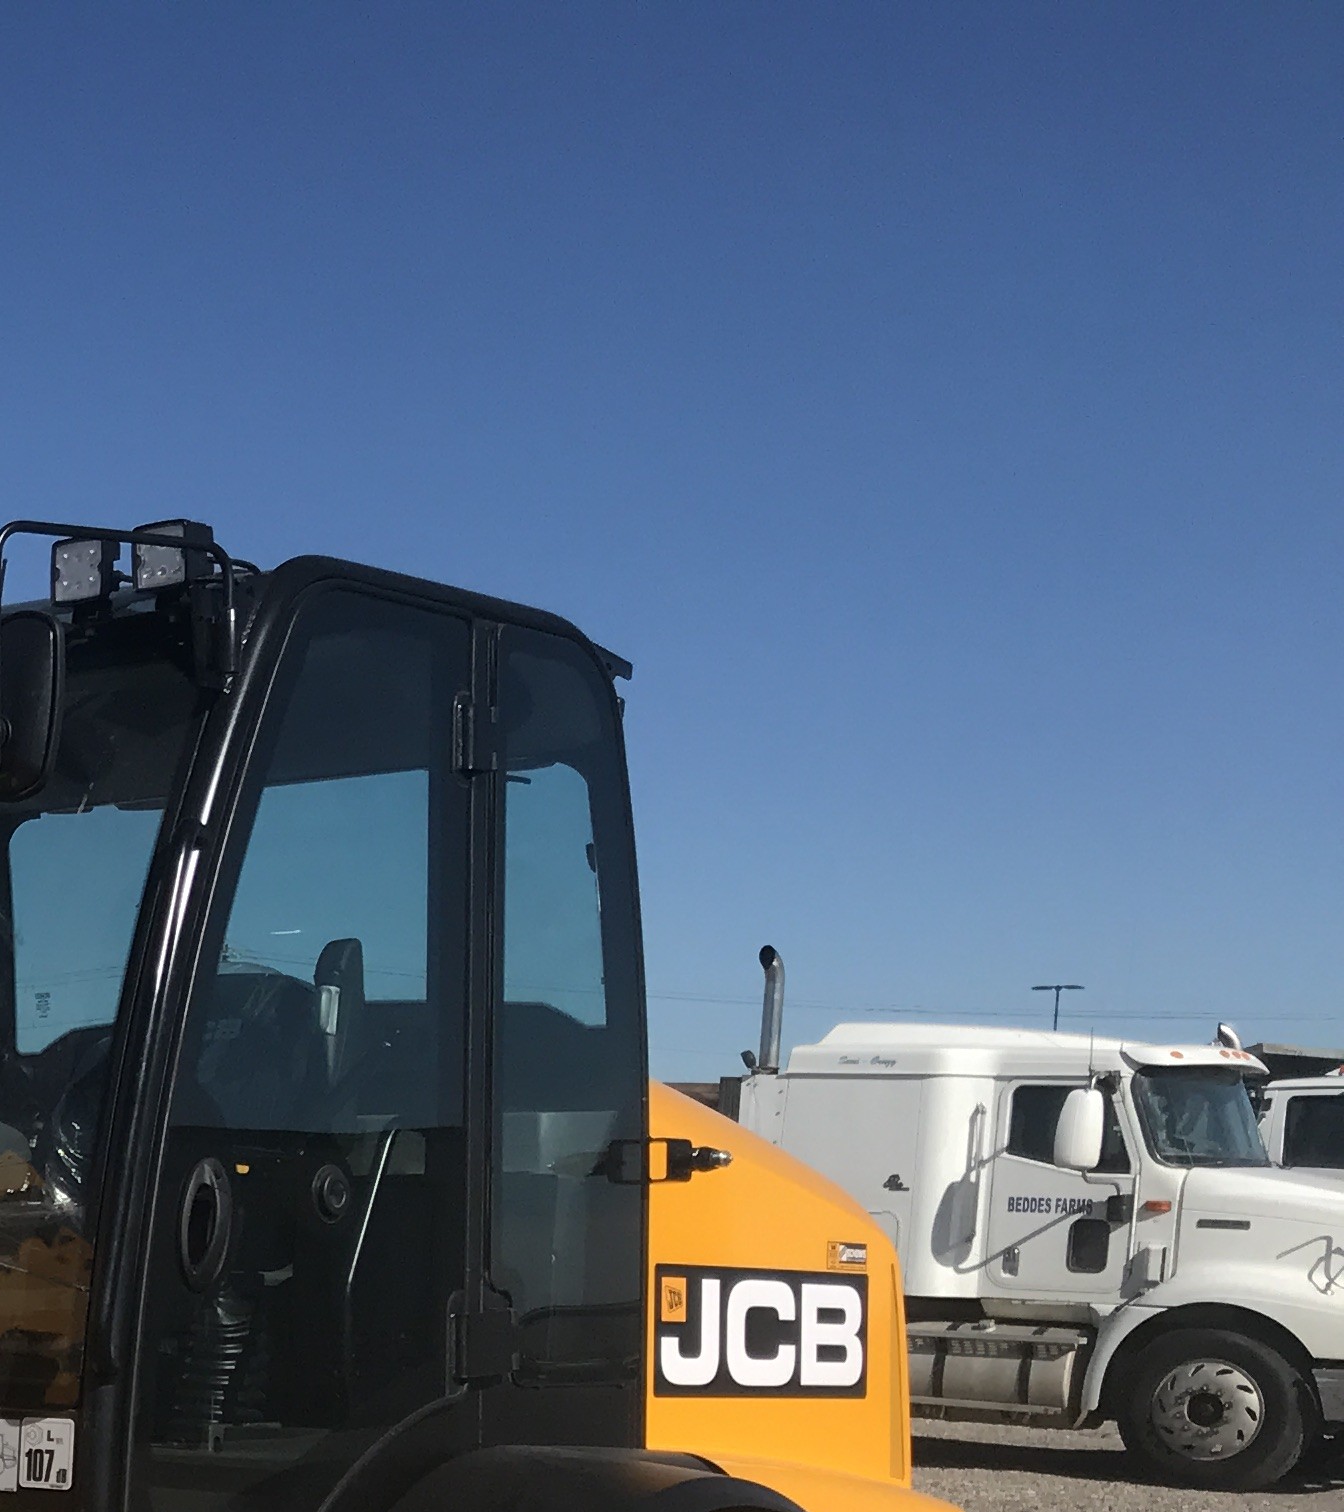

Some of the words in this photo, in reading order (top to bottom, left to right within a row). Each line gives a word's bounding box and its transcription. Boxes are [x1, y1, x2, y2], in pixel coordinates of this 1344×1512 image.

[1007, 1197, 1052, 1213] BEDDES
[1054, 1198, 1093, 1216] FARMS
[660, 1279, 863, 1386] JCB
[47, 1430, 55, 1442] L
[25, 1448, 56, 1483] 107
